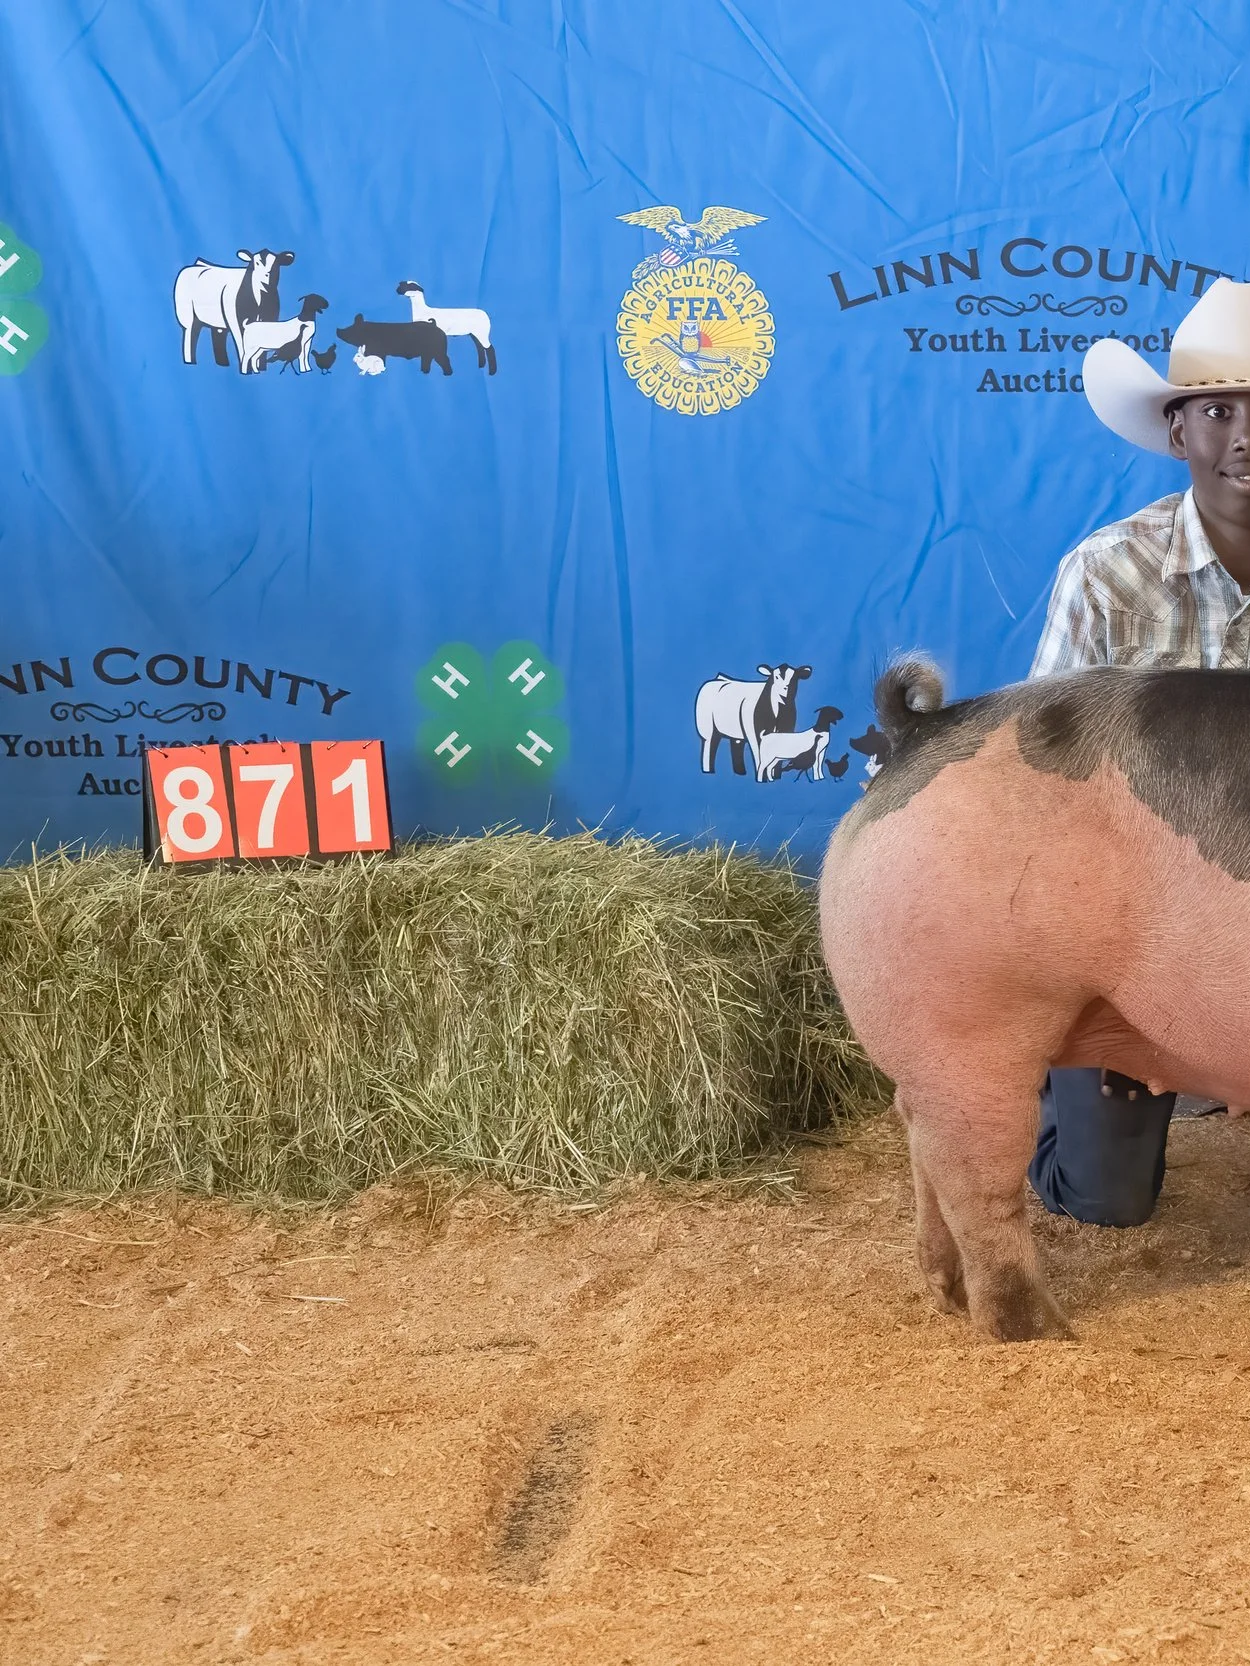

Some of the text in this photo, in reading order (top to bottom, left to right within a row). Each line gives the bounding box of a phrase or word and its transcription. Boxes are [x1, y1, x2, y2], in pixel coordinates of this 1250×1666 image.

[827, 237, 1234, 312] LINN COUNT
[640, 276, 751, 325] AGRICULTURAL
[666, 297, 728, 321] FFA
[904, 327, 1007, 353] Youth
[650, 362, 744, 393] EDUCATION
[976, 367, 1084, 393] Auctio
[0, 646, 352, 716] NN COUNTY
[431, 657, 546, 700] H H
[0, 733, 104, 757] Youth
[434, 729, 554, 768] H H
